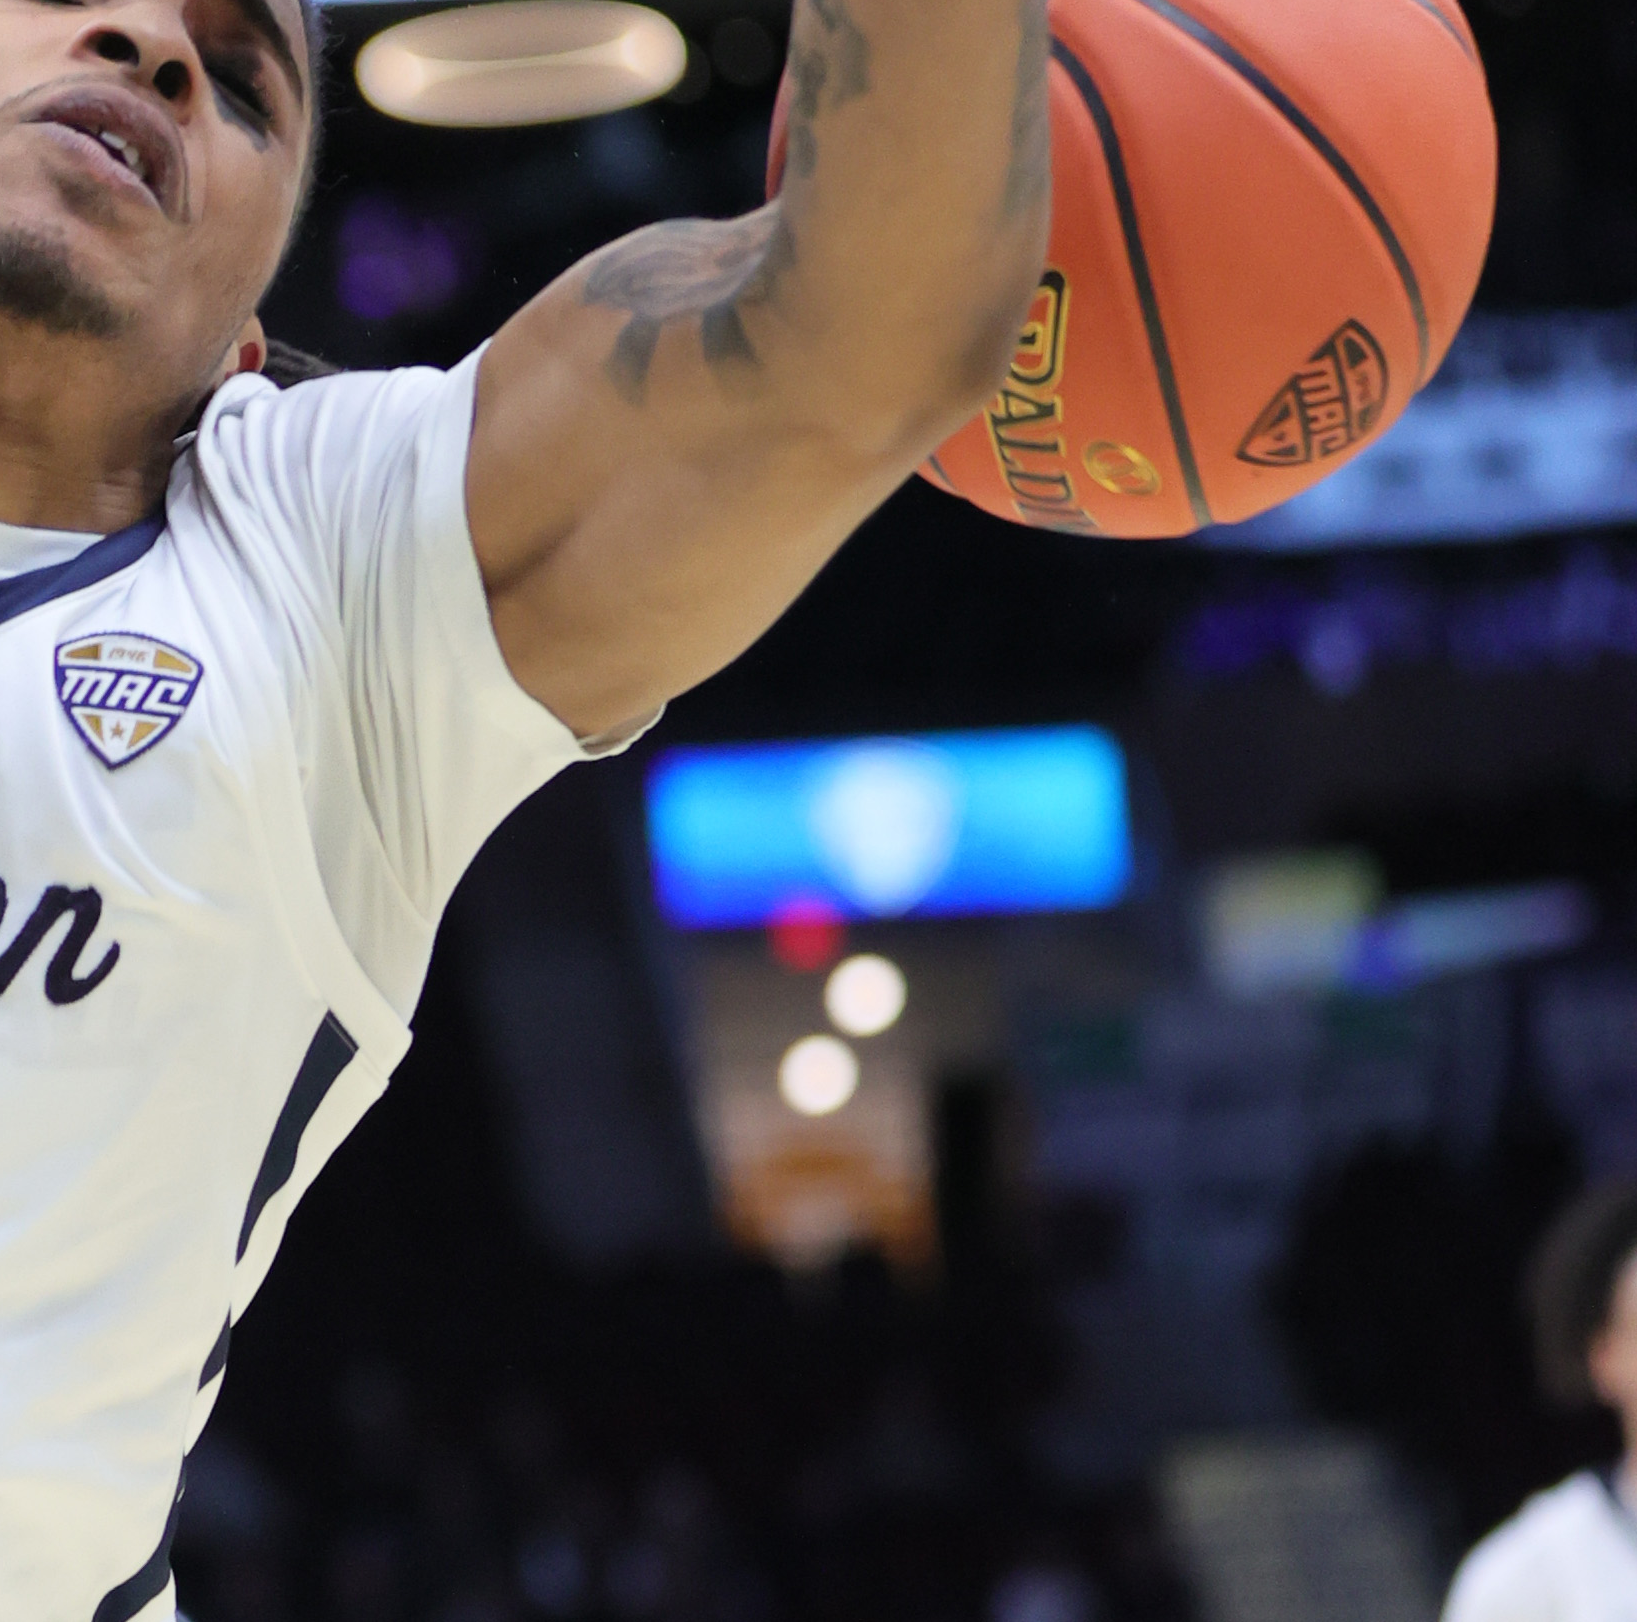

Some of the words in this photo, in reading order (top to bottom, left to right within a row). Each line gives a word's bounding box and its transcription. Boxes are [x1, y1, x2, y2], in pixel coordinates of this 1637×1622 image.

[1287, 349, 1354, 448] MAC
[108, 647, 149, 663] 1946
[61, 668, 191, 716] MAC
